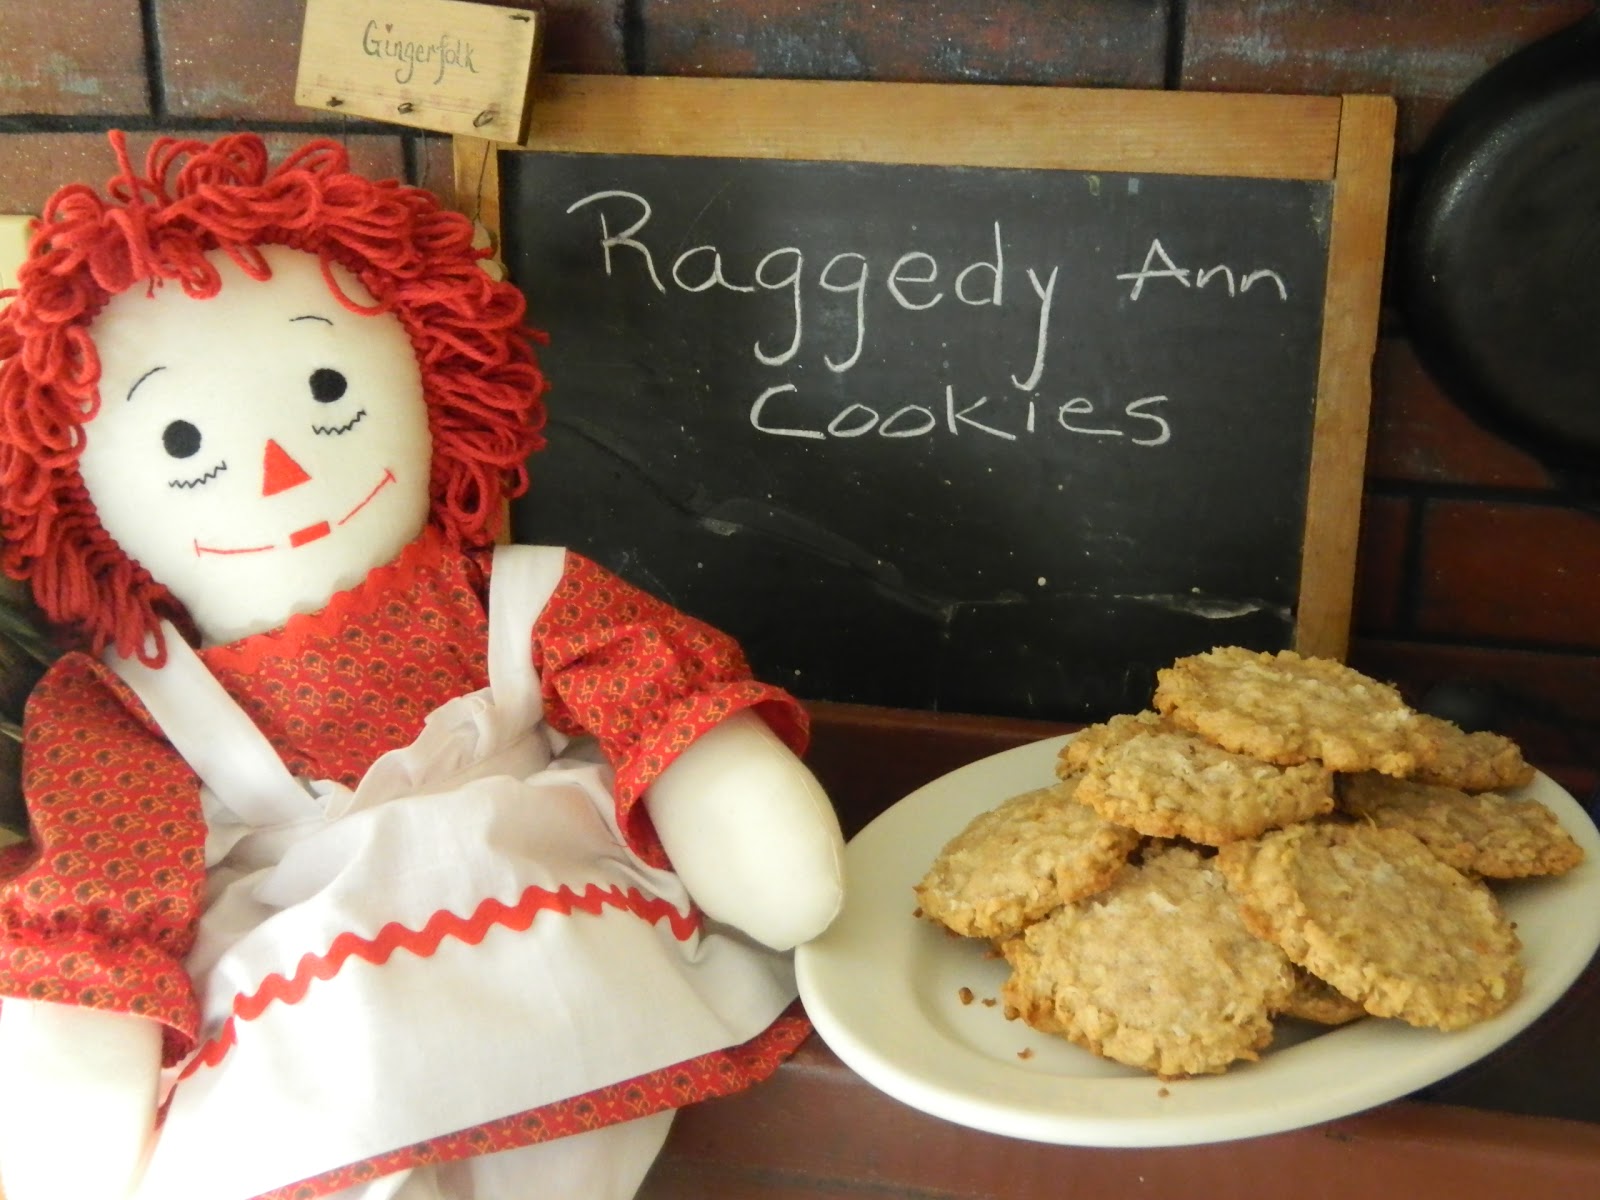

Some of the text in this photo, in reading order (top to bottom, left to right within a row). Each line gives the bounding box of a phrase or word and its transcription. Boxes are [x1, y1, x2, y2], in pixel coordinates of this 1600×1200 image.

[362, 19, 479, 85] Gingerfolk
[566, 189, 1288, 391] Raggedy Ann
[749, 383, 1171, 447] Cookies
